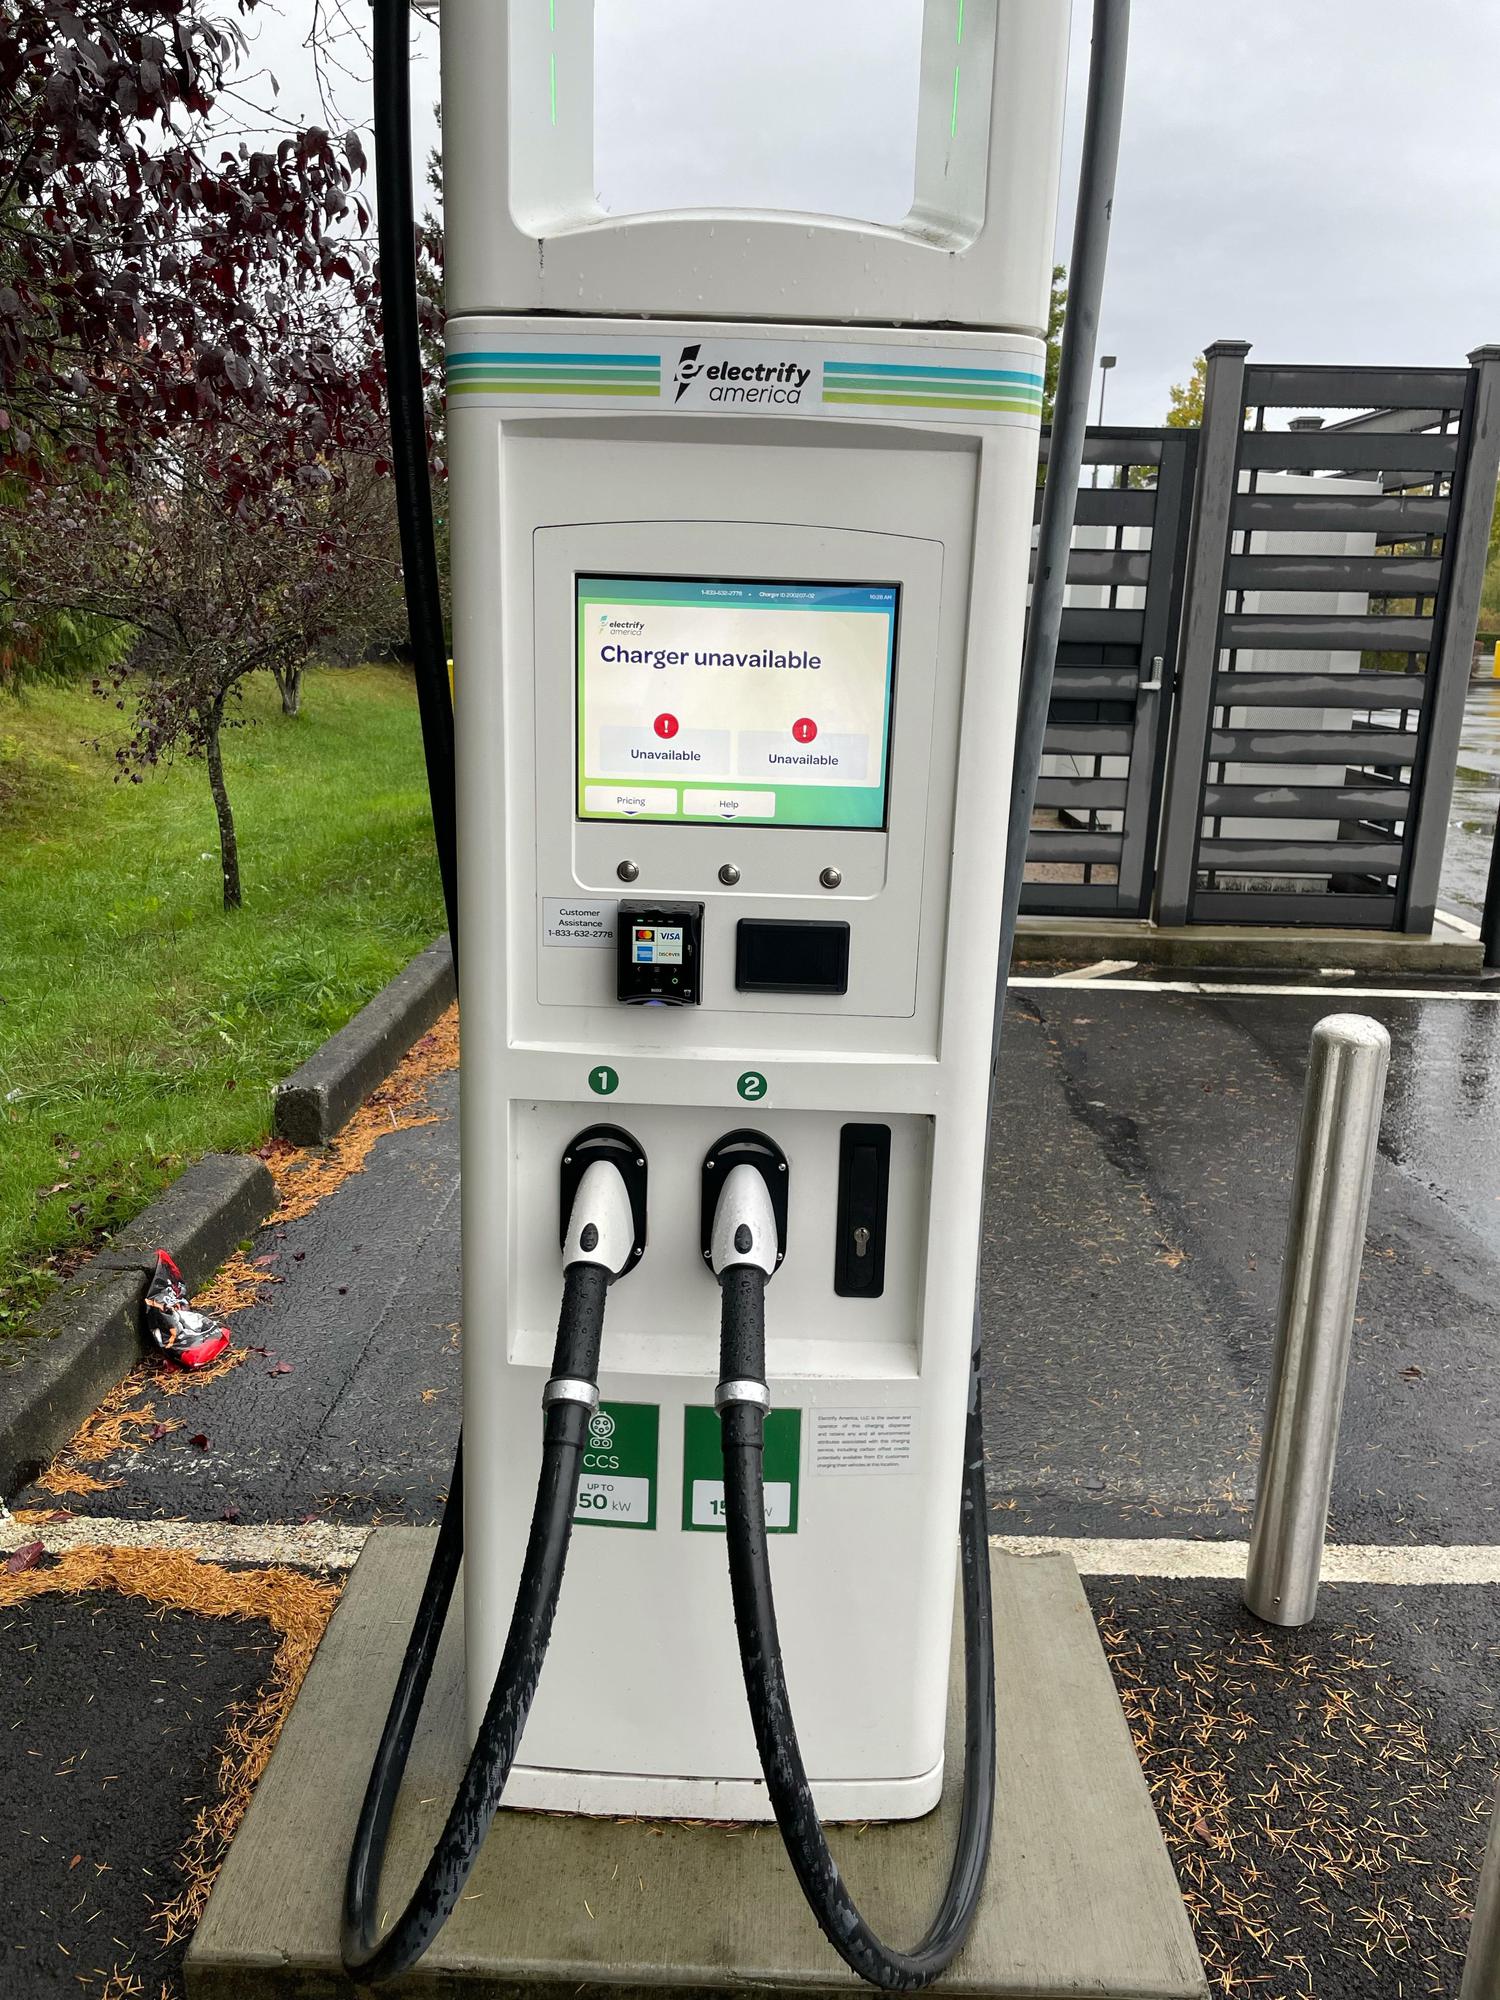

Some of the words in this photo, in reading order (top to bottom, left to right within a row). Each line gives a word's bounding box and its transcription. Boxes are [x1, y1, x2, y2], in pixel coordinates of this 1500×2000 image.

[706, 361, 811, 388] electrify
[709, 385, 801, 404] america
[609, 620, 645, 630] electrify
[610, 628, 642, 636] america
[600, 645, 689, 669] Charger
[694, 650, 822, 669] unavailable
[630, 749, 701, 761] Unavailable
[768, 754, 839, 765] Unavailable
[616, 796, 646, 807] Pricing
[719, 800, 739, 809] Help
[559, 908, 600, 916] Customer
[558, 919, 603, 927] Assistance
[548, 929, 614, 938] 1-833-632-2778
[660, 932, 680, 940] VISA
[744, 1076, 760, 1096] 2
[583, 1453, 620, 1469] CCS
[612, 1501, 631, 1511] kW
